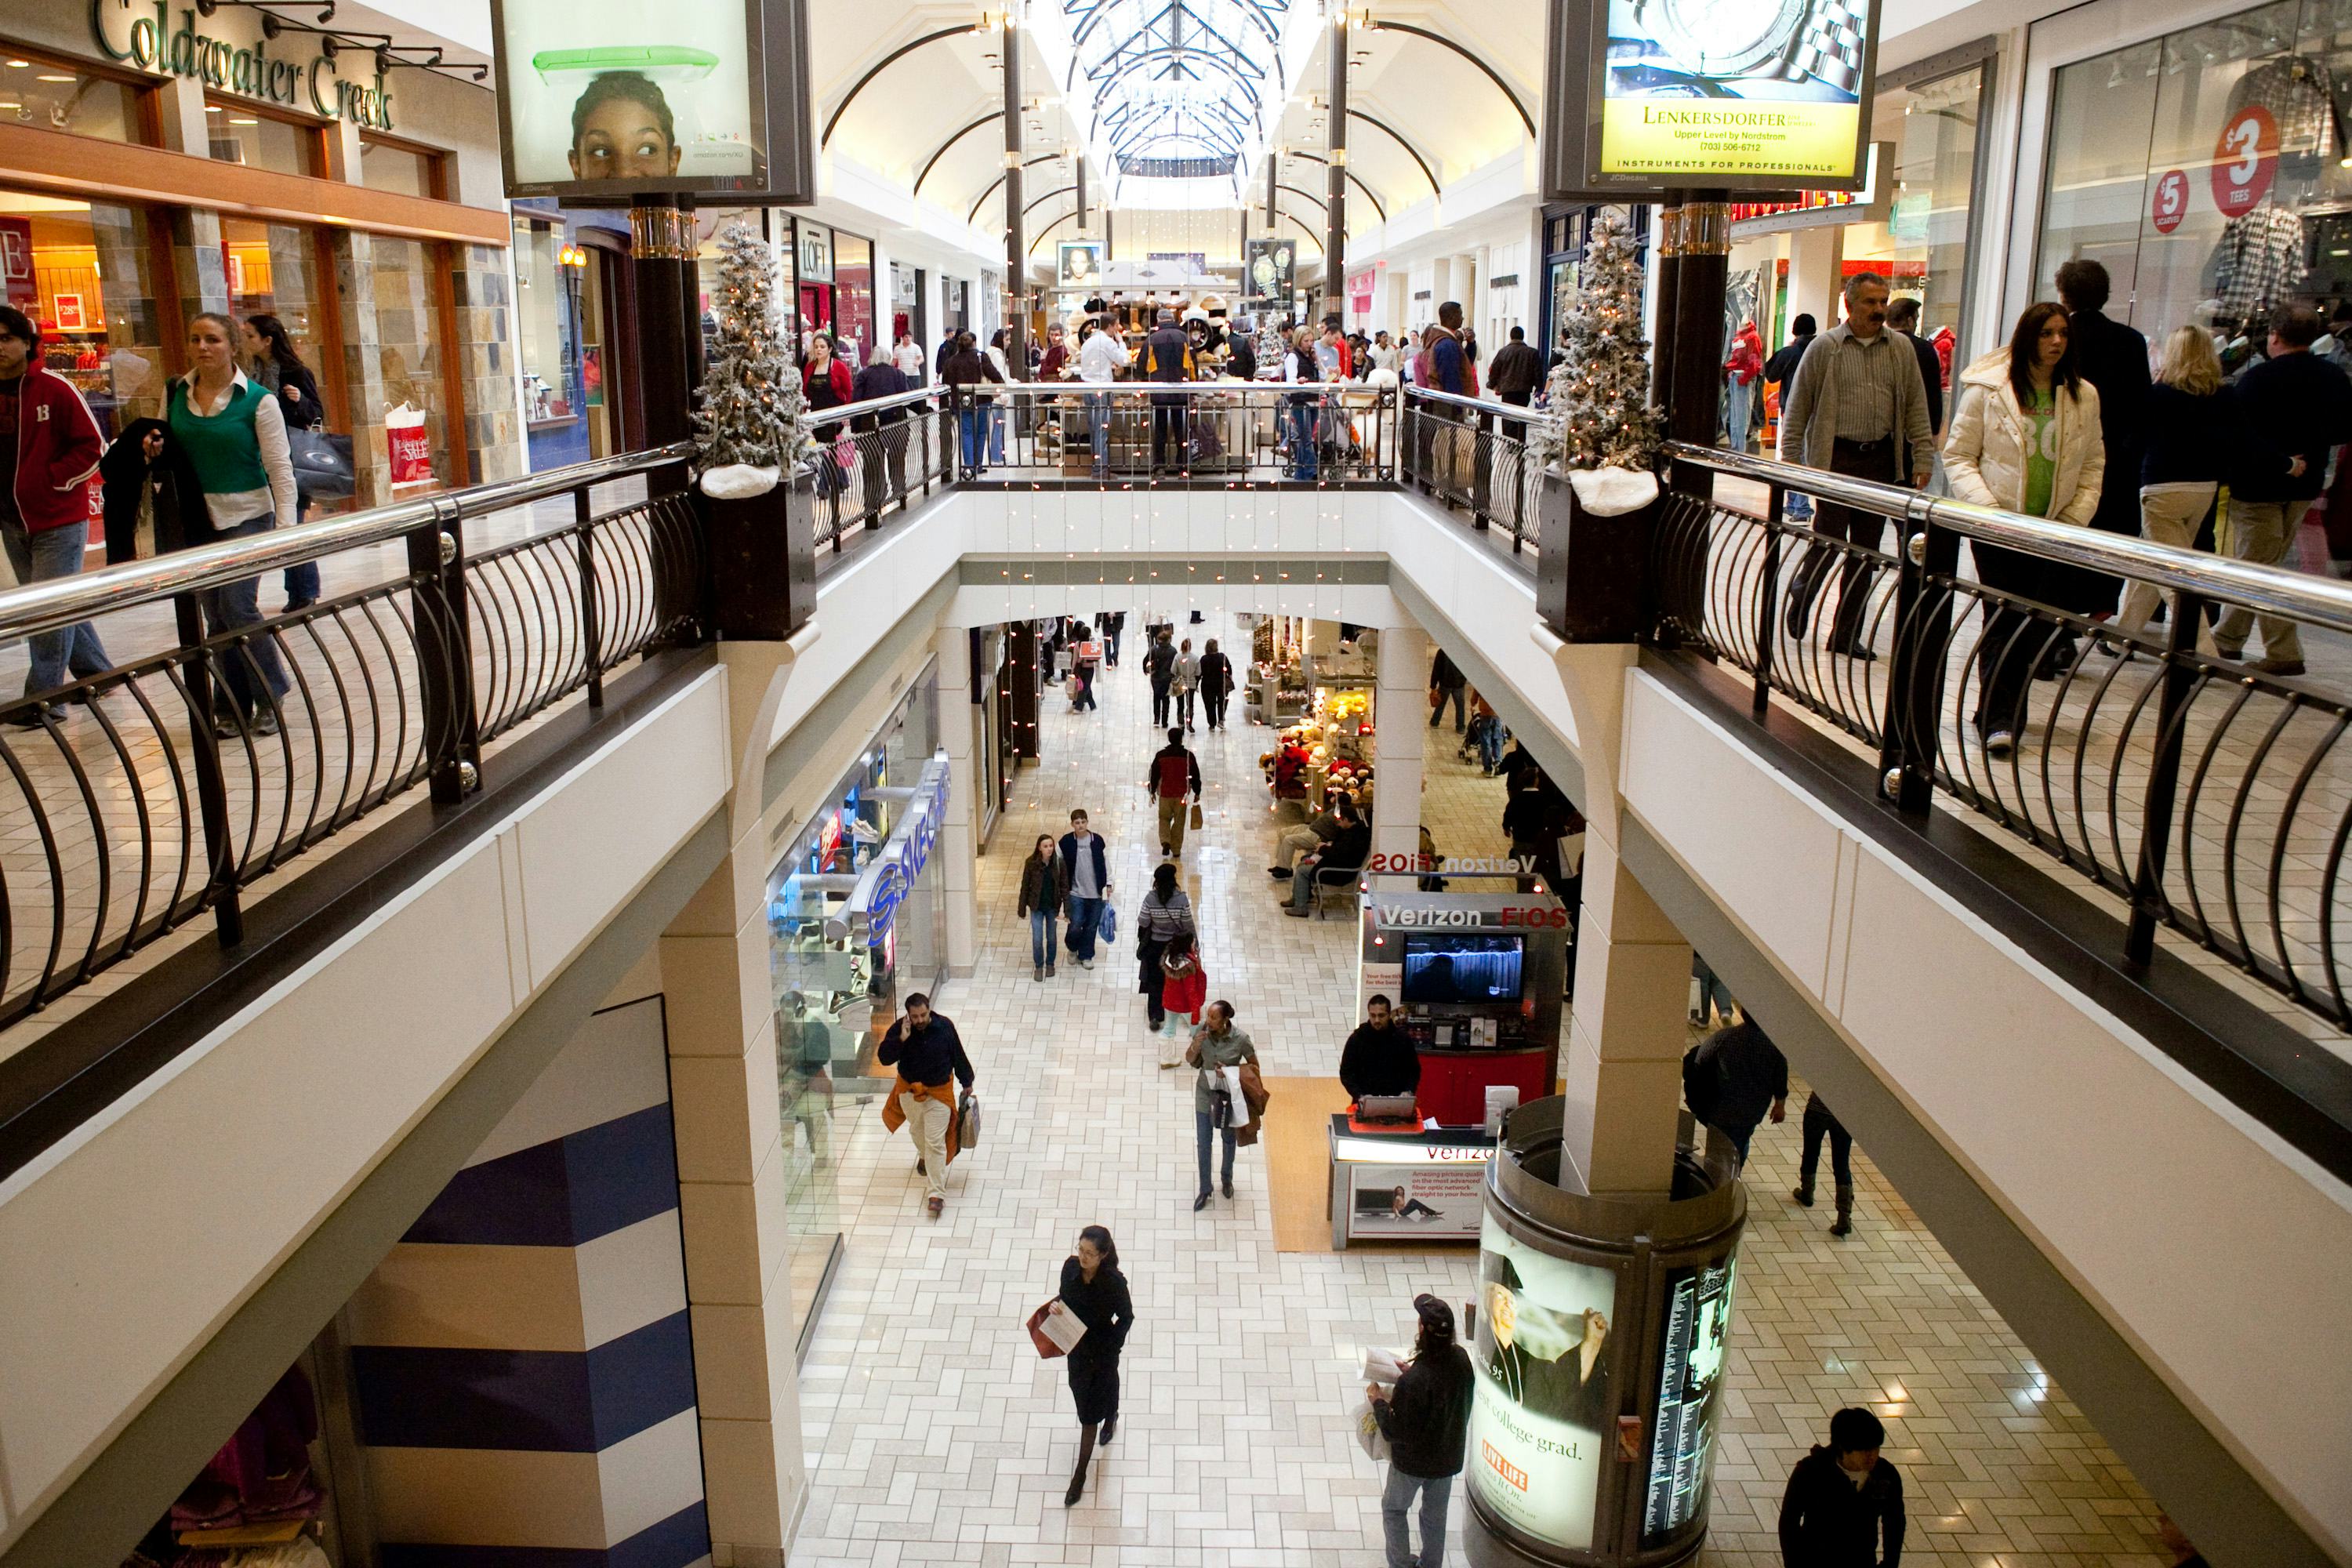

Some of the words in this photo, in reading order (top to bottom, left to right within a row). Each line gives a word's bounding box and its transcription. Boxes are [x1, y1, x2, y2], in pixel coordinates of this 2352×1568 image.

[91, 0, 303, 105] Coldwater
[309, 56, 394, 131] Creek
[1675, 130, 1701, 140] Upper
[1729, 132, 1740, 141] by
[1741, 132, 1786, 141] Nordstrom
[1700, 143, 1721, 152] (703)
[1722, 143, 1761, 152] 506-6712
[1617, 160, 1705, 169] INSTRUMENTS
[2230, 188, 2250, 203] TEES
[2156, 216, 2180, 226] SCARVES
[803, 239, 826, 274] LOFT
[404, 441, 430, 462] SALE
[1383, 904, 1482, 927] Verizon
[1501, 907, 1568, 929] FiOS
[1492, 1364, 1503, 1381] 95
[1492, 1404, 1534, 1443] college
[1537, 1438, 1582, 1461] grad.
[1484, 1441, 1503, 1472] LIVE
[1503, 1461, 1526, 1489] LIFE
